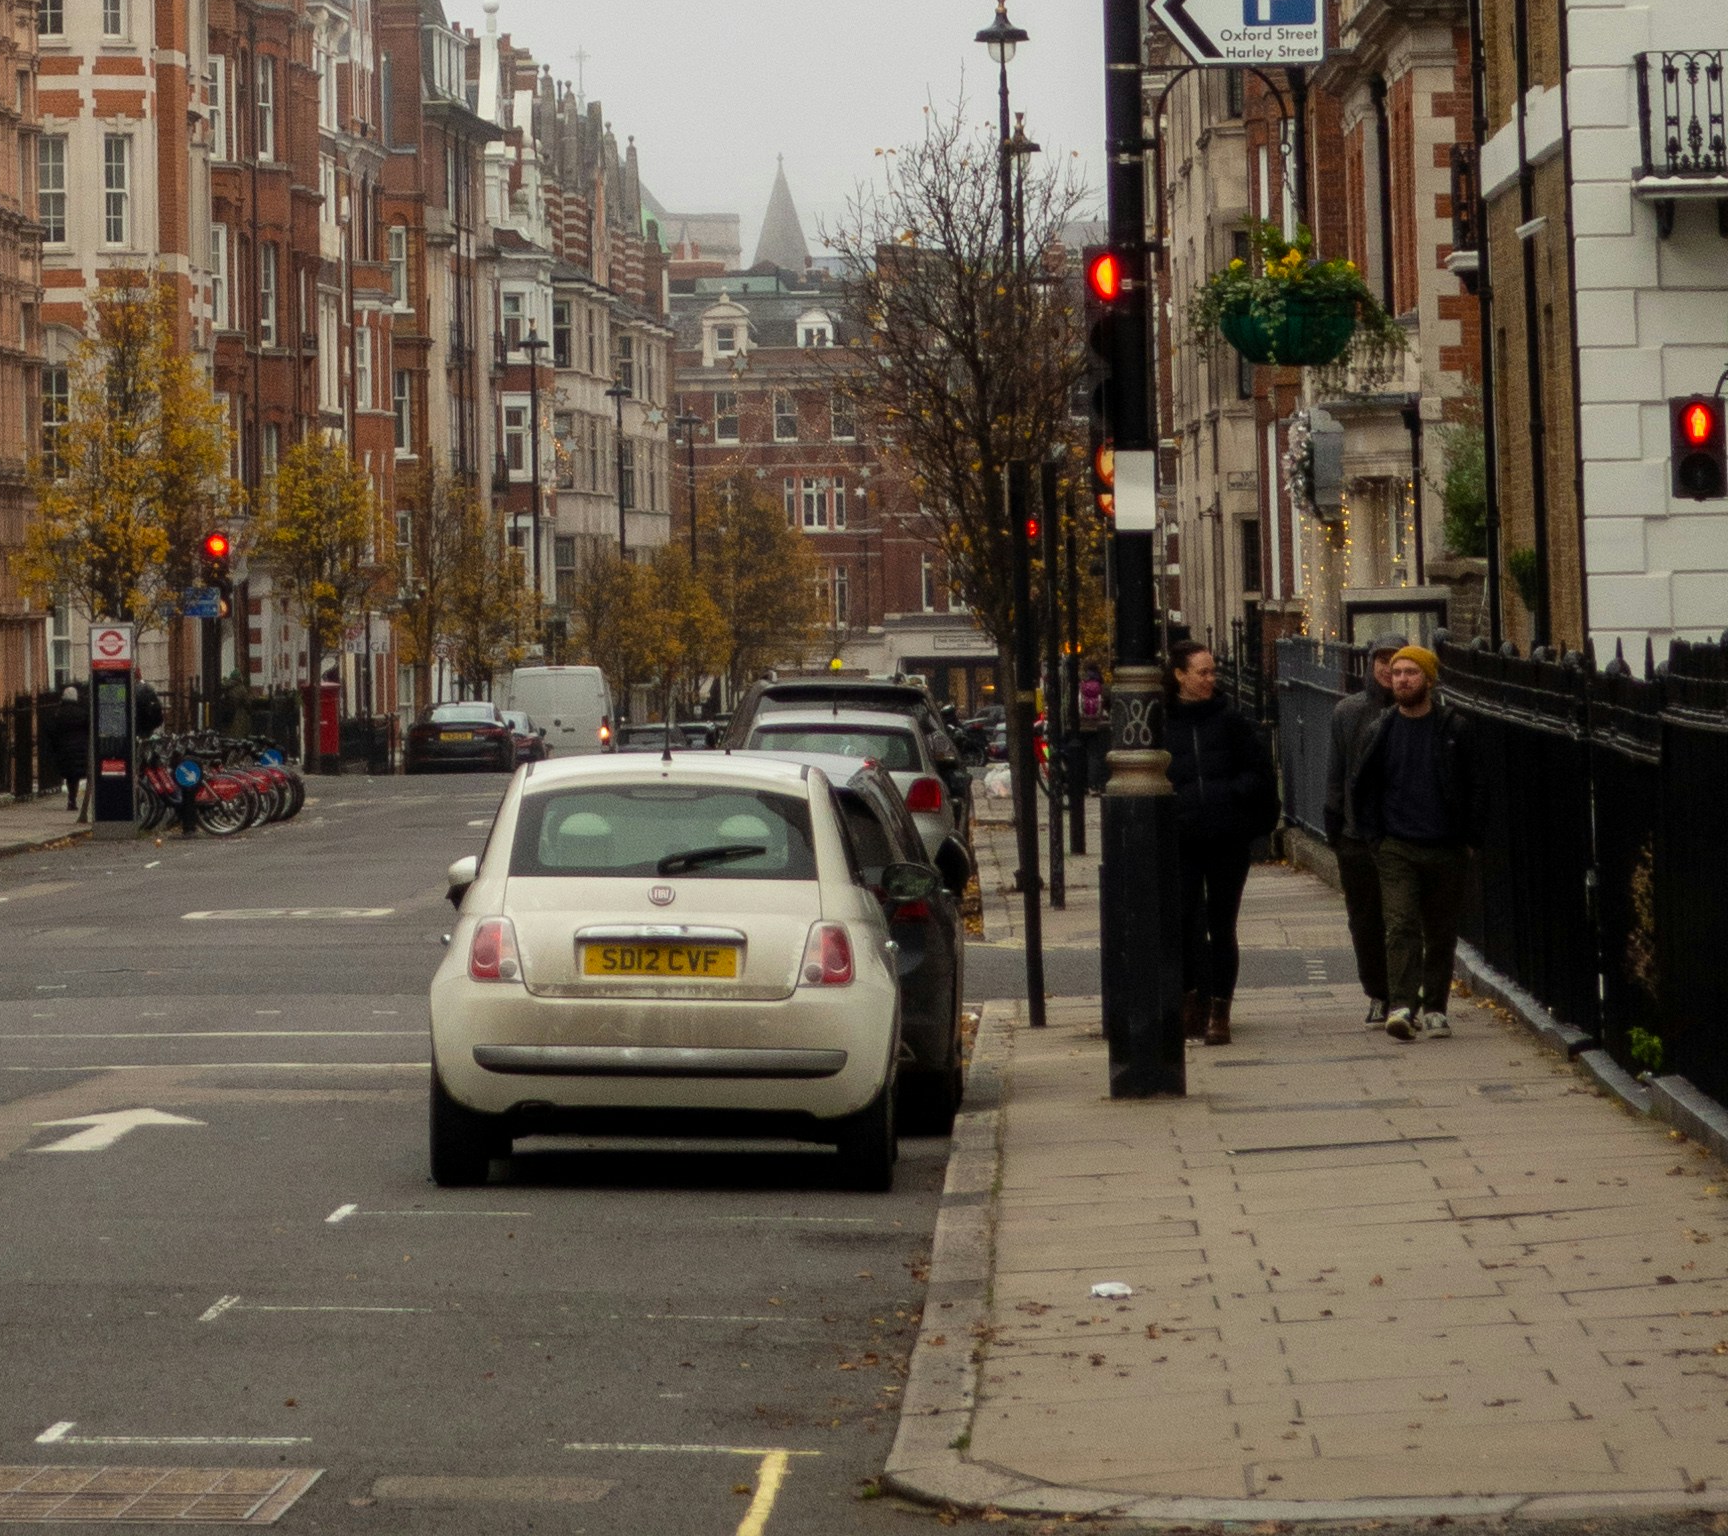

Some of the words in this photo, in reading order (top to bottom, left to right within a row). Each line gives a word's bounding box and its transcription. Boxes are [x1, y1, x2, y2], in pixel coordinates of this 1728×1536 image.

[1220, 27, 1272, 42] Oxford
[1277, 27, 1318, 40] Street
[1226, 44, 1273, 61] Harley
[1278, 45, 1319, 57] Street
[654, 888, 670, 900] FIAT
[602, 948, 660, 971] SD12
[668, 948, 720, 972] CVF
